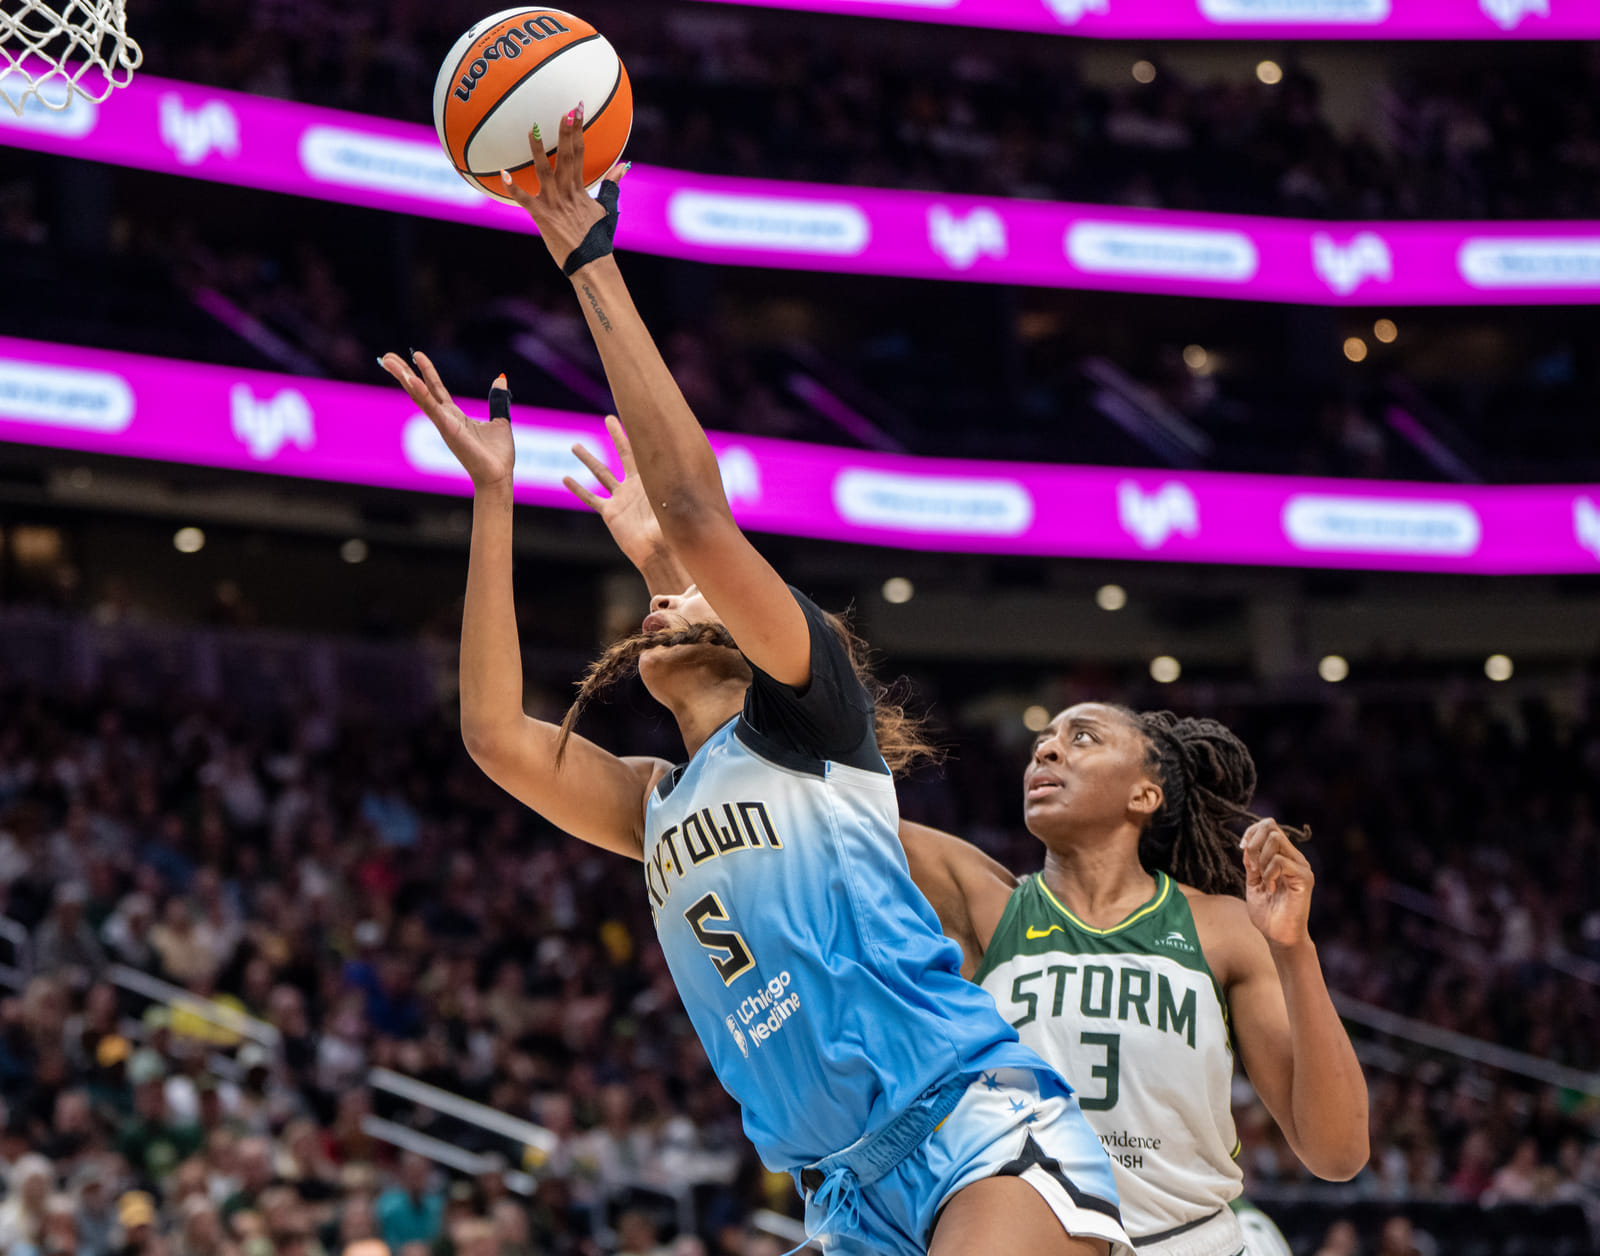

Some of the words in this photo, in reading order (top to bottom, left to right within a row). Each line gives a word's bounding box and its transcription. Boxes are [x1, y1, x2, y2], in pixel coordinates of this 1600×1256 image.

[453, 15, 571, 103] Wilson
[683, 890, 757, 988] 5
[1010, 964, 1197, 1050] STORM
[1078, 1031, 1120, 1111] 3
[1100, 1130, 1161, 1150] vidence
